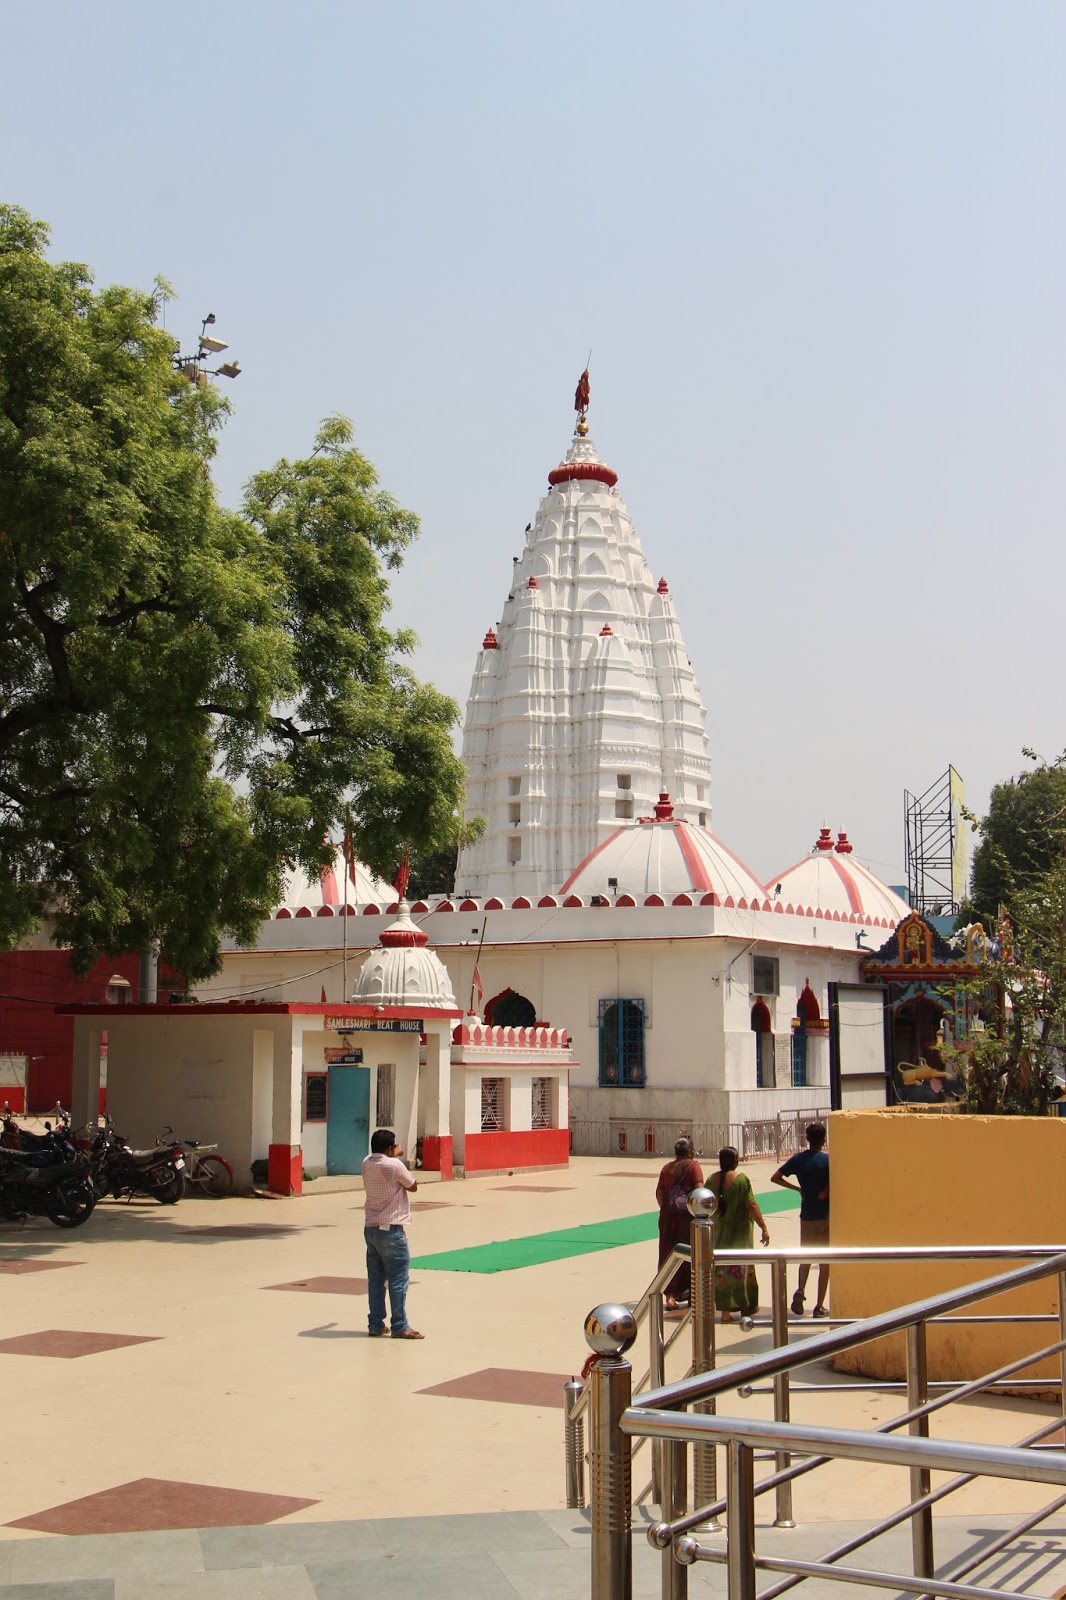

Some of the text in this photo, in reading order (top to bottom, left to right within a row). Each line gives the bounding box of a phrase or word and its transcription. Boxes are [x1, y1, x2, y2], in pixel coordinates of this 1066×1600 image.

[326, 1018, 420, 1031] SAMLESWARI BEAT HOUSE
